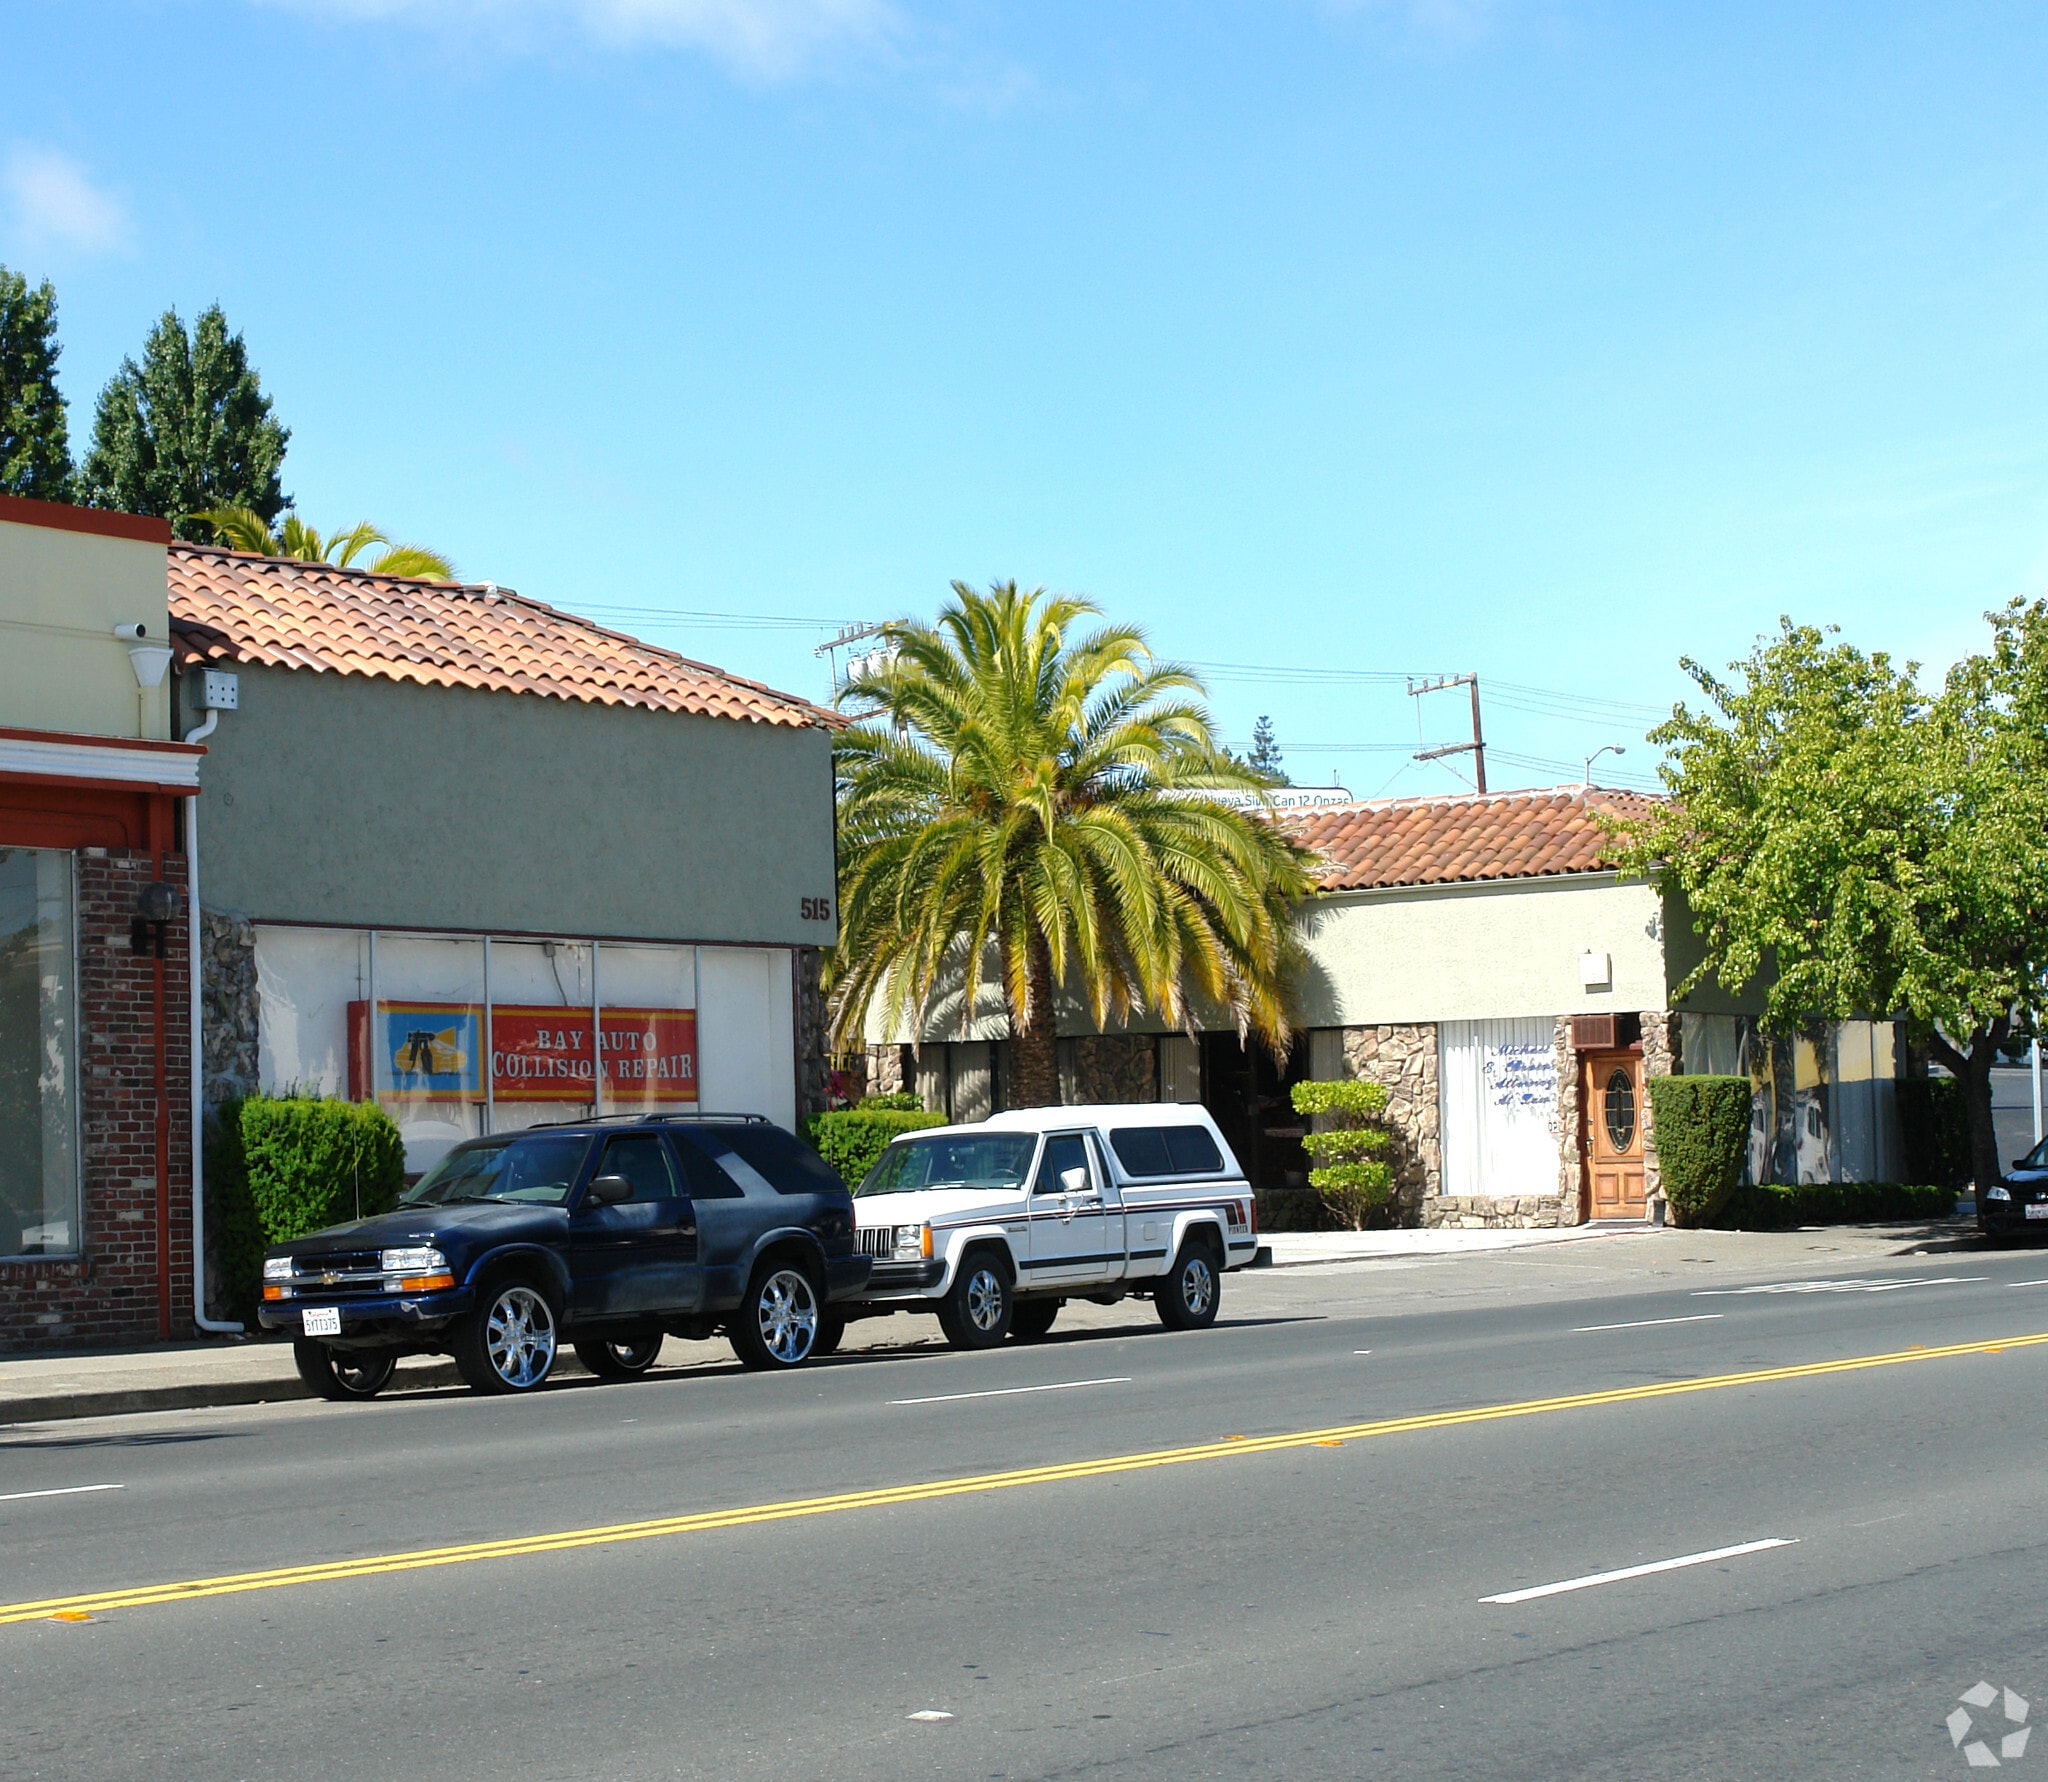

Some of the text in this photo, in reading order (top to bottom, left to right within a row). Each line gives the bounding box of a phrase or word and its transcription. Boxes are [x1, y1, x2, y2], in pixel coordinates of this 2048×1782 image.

[1273, 795, 1295, 806] Can
[1299, 795, 1310, 806] 12
[1314, 795, 1349, 806] Onzas
[801, 897, 831, 920] 515
[537, 1030, 657, 1051] BAY AUTO
[493, 1051, 693, 1079] COLLISION REPAIR
